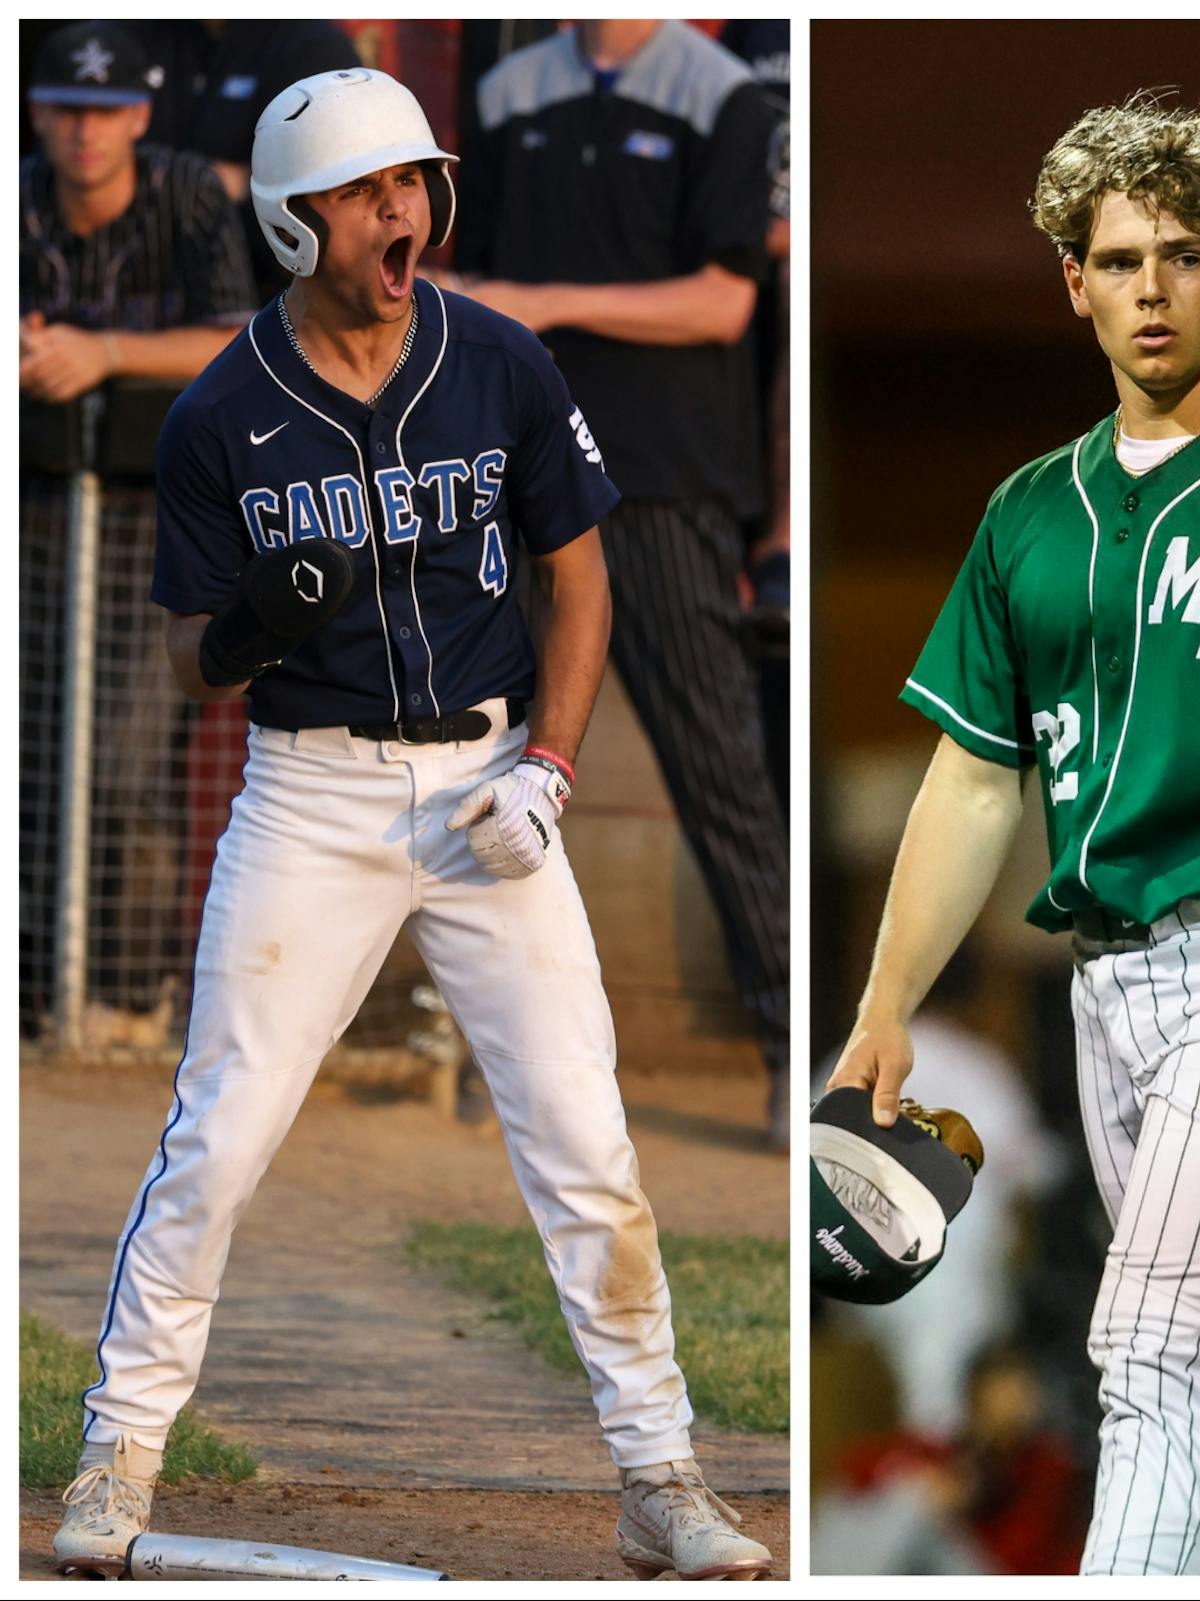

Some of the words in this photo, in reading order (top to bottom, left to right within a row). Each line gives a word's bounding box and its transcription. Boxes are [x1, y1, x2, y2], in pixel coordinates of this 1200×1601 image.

[239, 448, 507, 555] CADETS
[478, 520, 508, 599] 4
[815, 1224, 870, 1281] Mustangs
